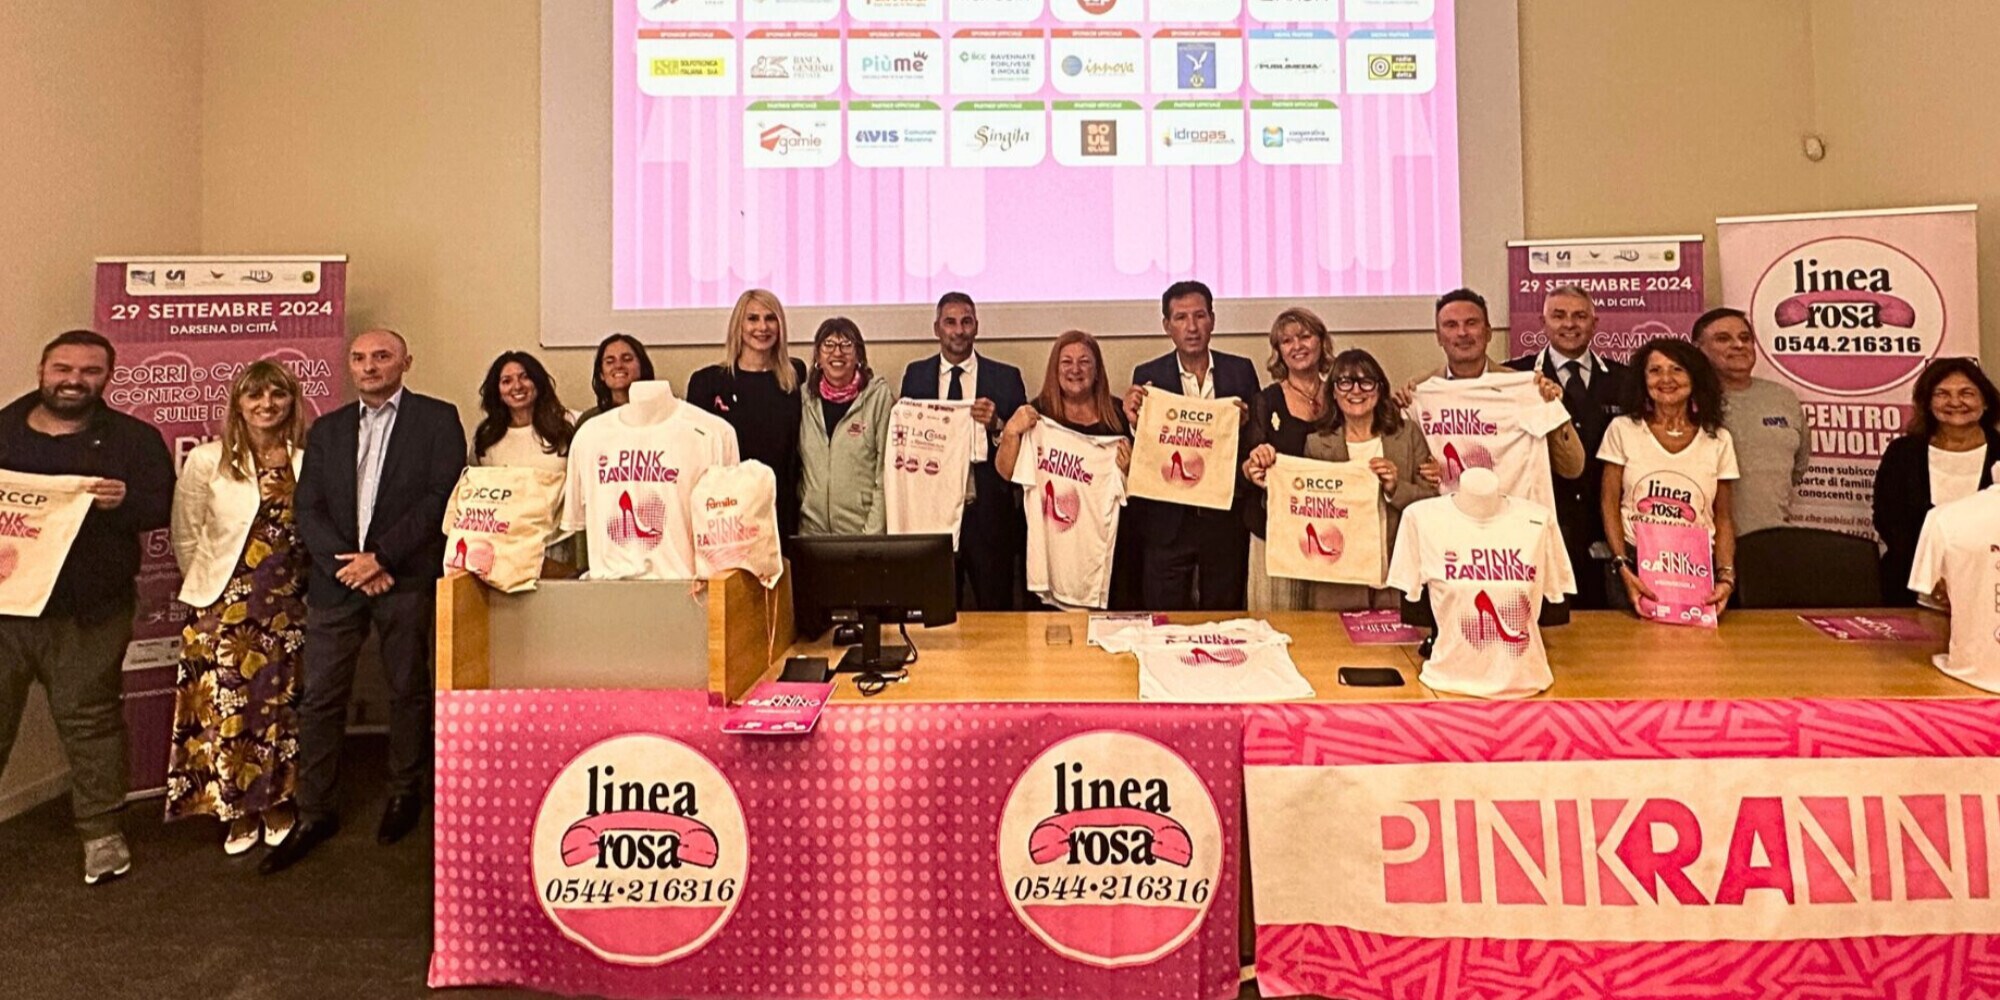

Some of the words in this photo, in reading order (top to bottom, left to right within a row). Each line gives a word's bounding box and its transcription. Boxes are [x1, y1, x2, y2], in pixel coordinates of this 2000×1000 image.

[855, 130, 899, 143] AVIS
[1174, 127, 1226, 142] idrogas
[1520, 279, 1540, 293] 29
[1646, 276, 1692, 291] 2024
[1794, 259, 1892, 293] linea
[111, 304, 141, 320] 29
[149, 302, 273, 319] SETTEMBRE
[279, 300, 333, 316] 2024
[1607, 299, 1618, 307] DI
[1805, 303, 1883, 329] rosa
[170, 323, 227, 335] DARSENA
[231, 322, 243, 333] DI
[1774, 336, 1921, 353] 0544.216316
[110, 365, 188, 386] CORRI
[110, 387, 200, 405] CONTRO
[206, 386, 230, 401] LA
[154, 406, 208, 423] SULLE
[1180, 409, 1213, 422] RCCP
[1441, 409, 1481, 424] PINK
[1801, 404, 1900, 430] CENTRO
[1176, 426, 1205, 439] PINK
[619, 450, 664, 467] PINK
[1049, 448, 1085, 470] PINK
[1038, 458, 1094, 486] ANNING
[1808, 465, 1835, 474] onne
[1306, 478, 1343, 490] RCCP
[1828, 477, 1838, 487] di
[1648, 480, 1691, 504] linea
[1798, 489, 1853, 501] conoscenti
[1305, 496, 1335, 508] PINK
[1652, 504, 1682, 519] rosa
[708, 514, 744, 531] PINK
[1471, 549, 1521, 566] PINK
[1659, 551, 1690, 563] PINK
[586, 765, 698, 817] linea
[1054, 762, 1171, 814] linea
[595, 833, 683, 869] rosa
[1067, 830, 1157, 866] rosa
